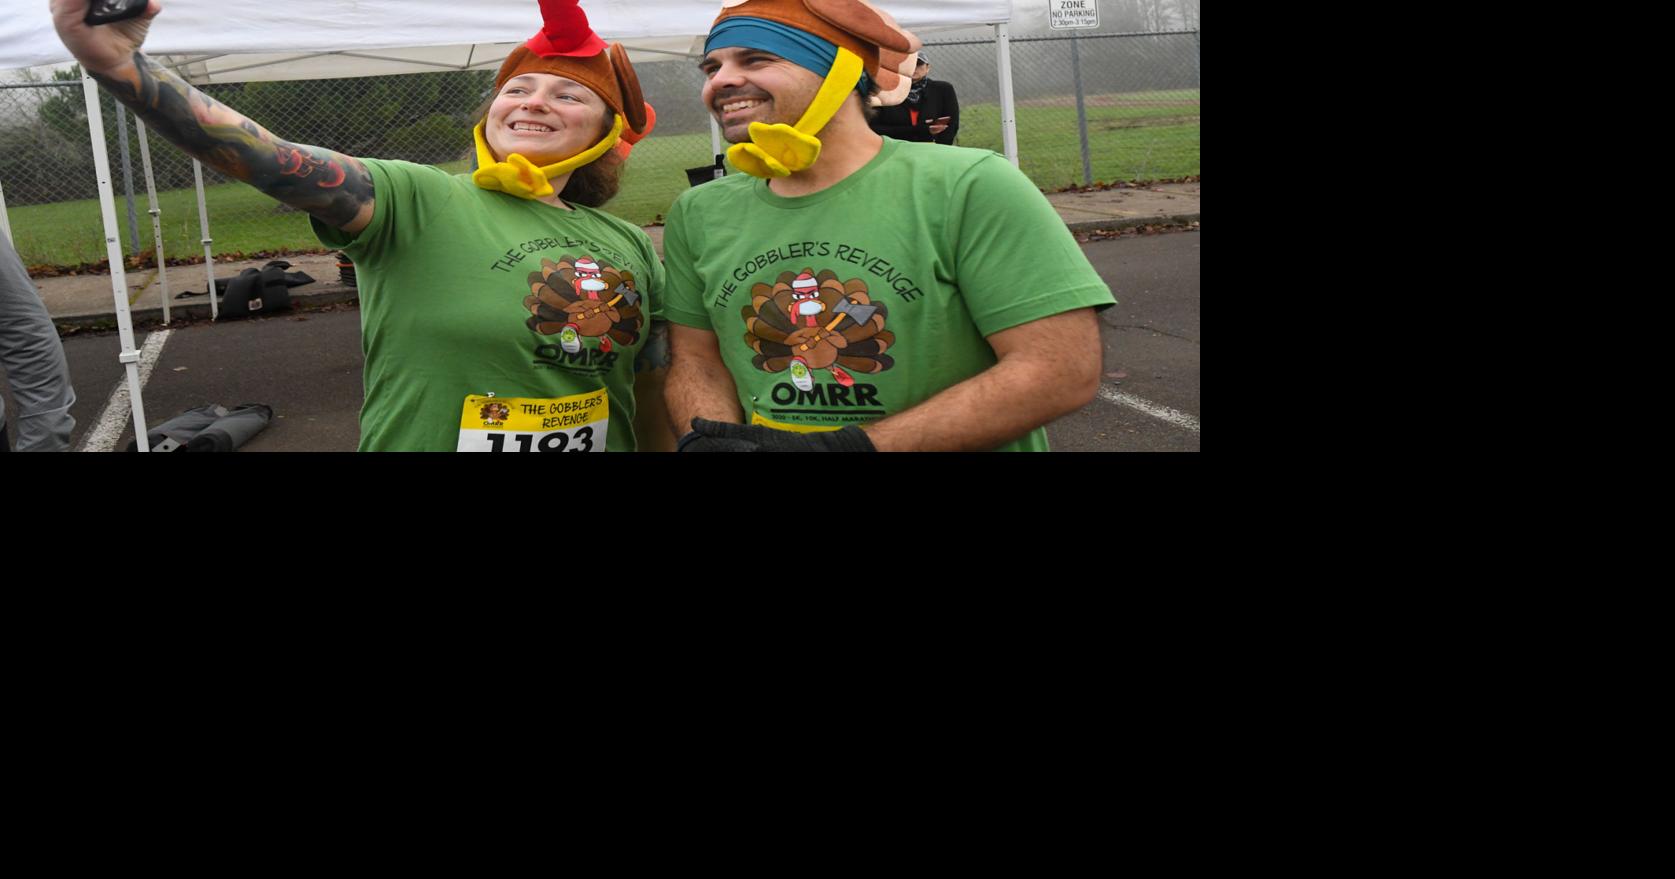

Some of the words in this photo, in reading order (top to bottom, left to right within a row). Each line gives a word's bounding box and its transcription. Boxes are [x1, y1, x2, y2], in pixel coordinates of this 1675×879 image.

[1061, 0, 1086, 9] ZONE
[1052, 10, 1063, 18] NO
[1064, 9, 1095, 17] PARKING
[491, 249, 526, 273] THE
[714, 282, 737, 310] THE
[733, 241, 830, 281] GOBBLER'S
[835, 245, 924, 303] REVENGE
[771, 382, 883, 407] OMRR
[520, 404, 546, 415] THE
[542, 412, 589, 429] REVENGE
[821, 415, 840, 423] HALF
